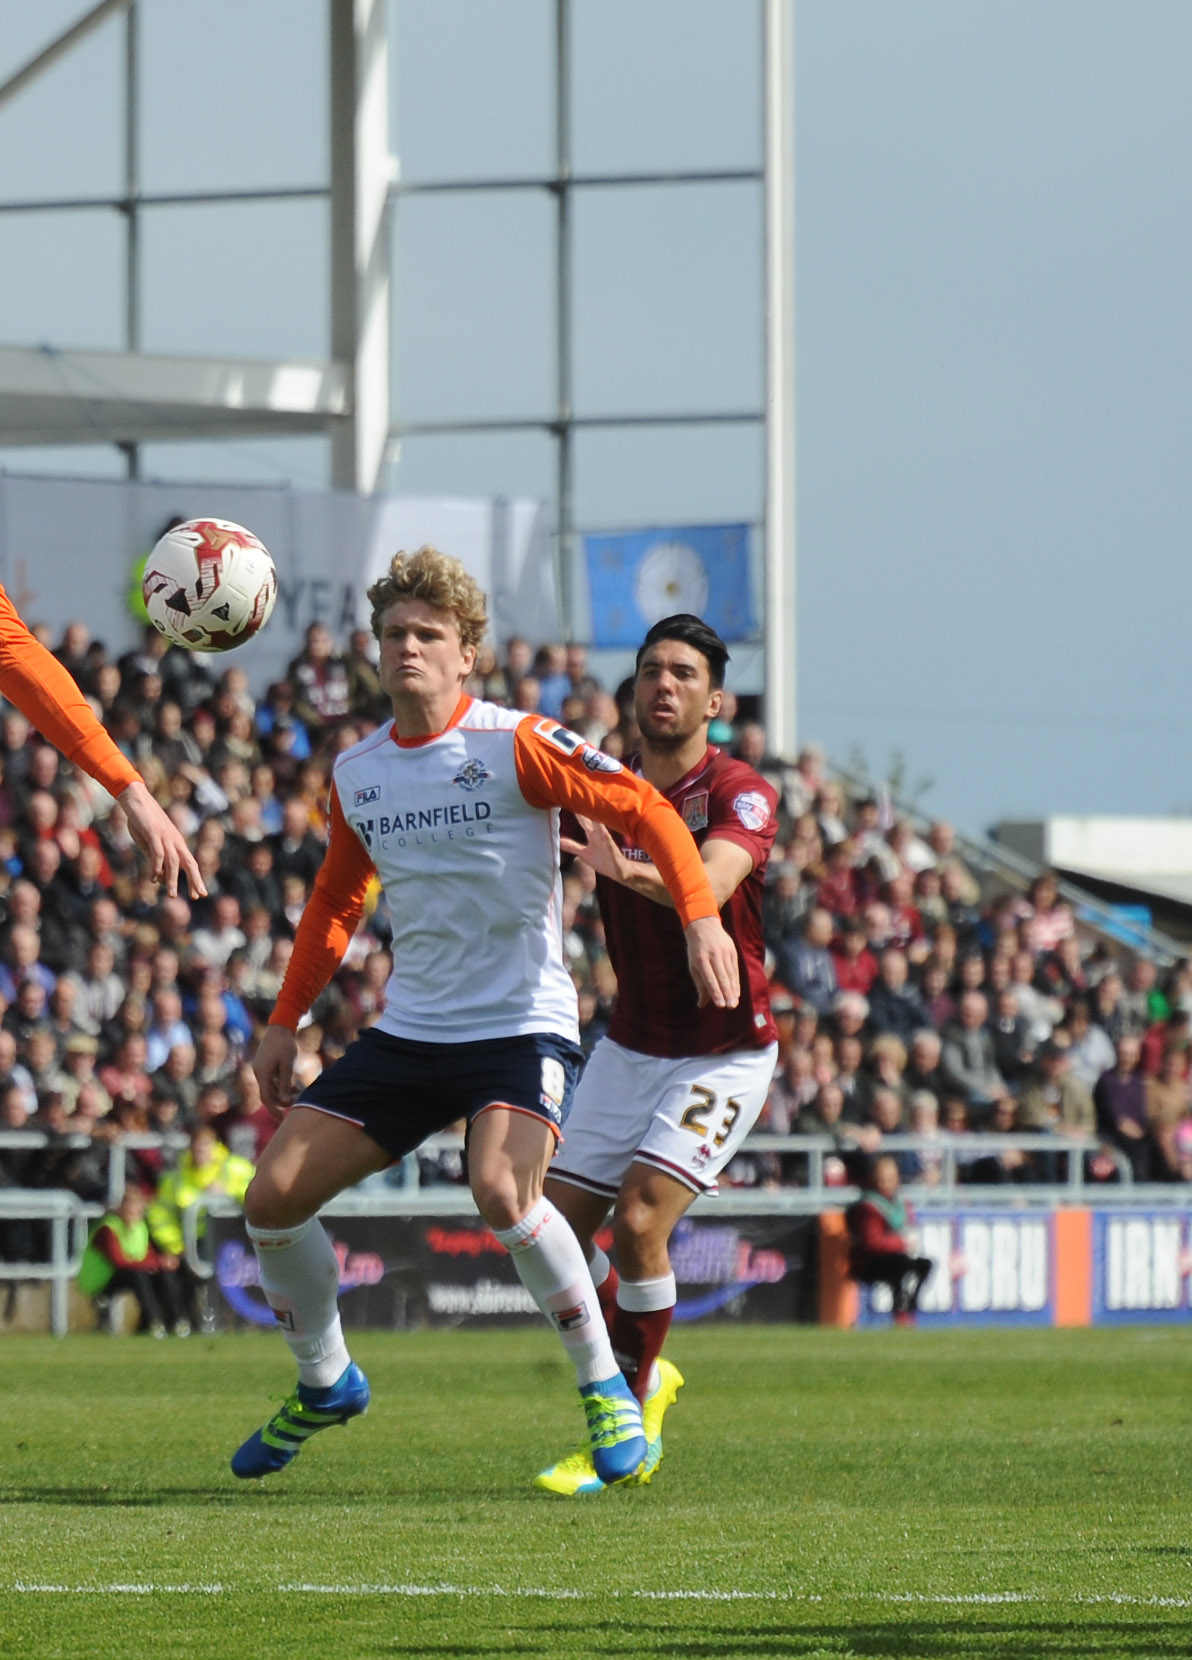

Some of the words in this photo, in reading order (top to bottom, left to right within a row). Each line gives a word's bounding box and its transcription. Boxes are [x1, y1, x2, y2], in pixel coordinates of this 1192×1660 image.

[356, 789, 378, 803] FILA
[379, 801, 492, 835] BARNFIELD
[382, 824, 494, 850] COLLEGE
[680, 1083, 742, 1148] 23
